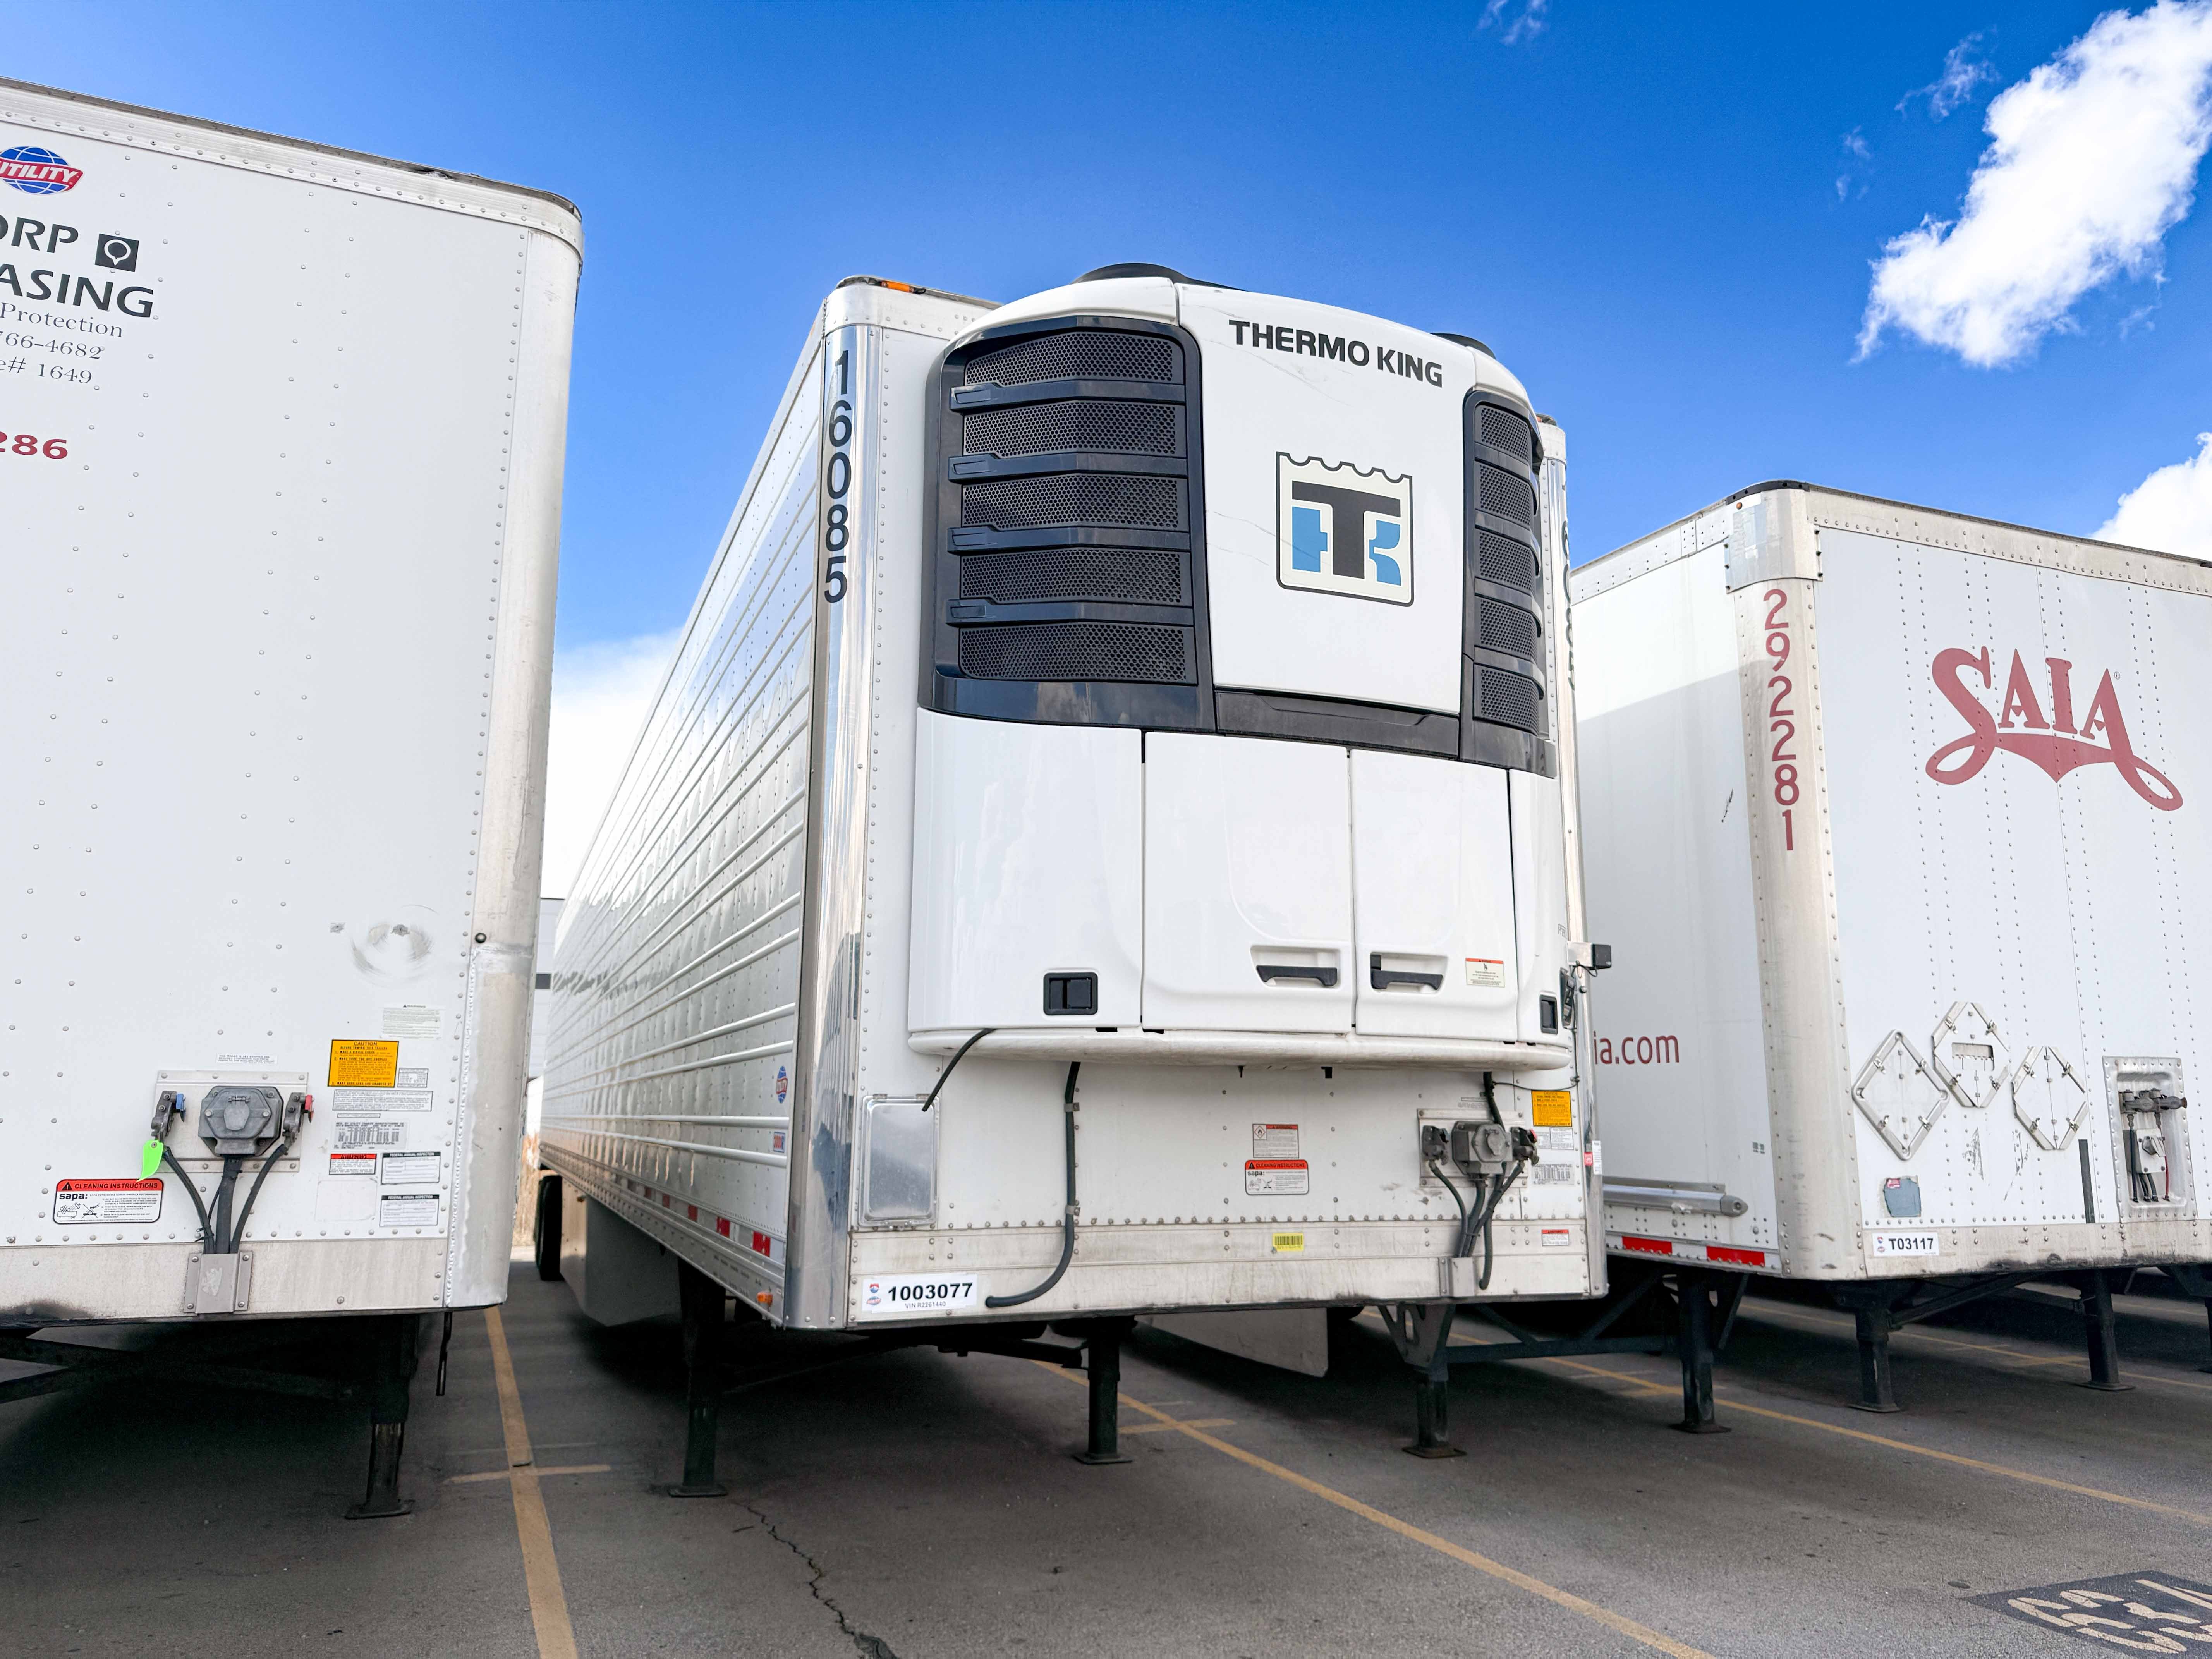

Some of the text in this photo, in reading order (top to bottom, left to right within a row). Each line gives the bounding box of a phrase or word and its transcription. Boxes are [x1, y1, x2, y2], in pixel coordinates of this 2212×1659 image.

[0, 263, 153, 318] ASING
[1, 302, 122, 337] Protection
[0, 331, 101, 359] 66-4682
[1229, 320, 1442, 388] THERMO KING
[38, 364, 92, 383] 1649
[824, 350, 852, 603] 16085
[1763, 589, 1800, 851] 292281
[1925, 646, 2183, 811] SAIA
[1888, 1238, 1934, 1250] T03117
[888, 1282, 973, 1302] 1003077
